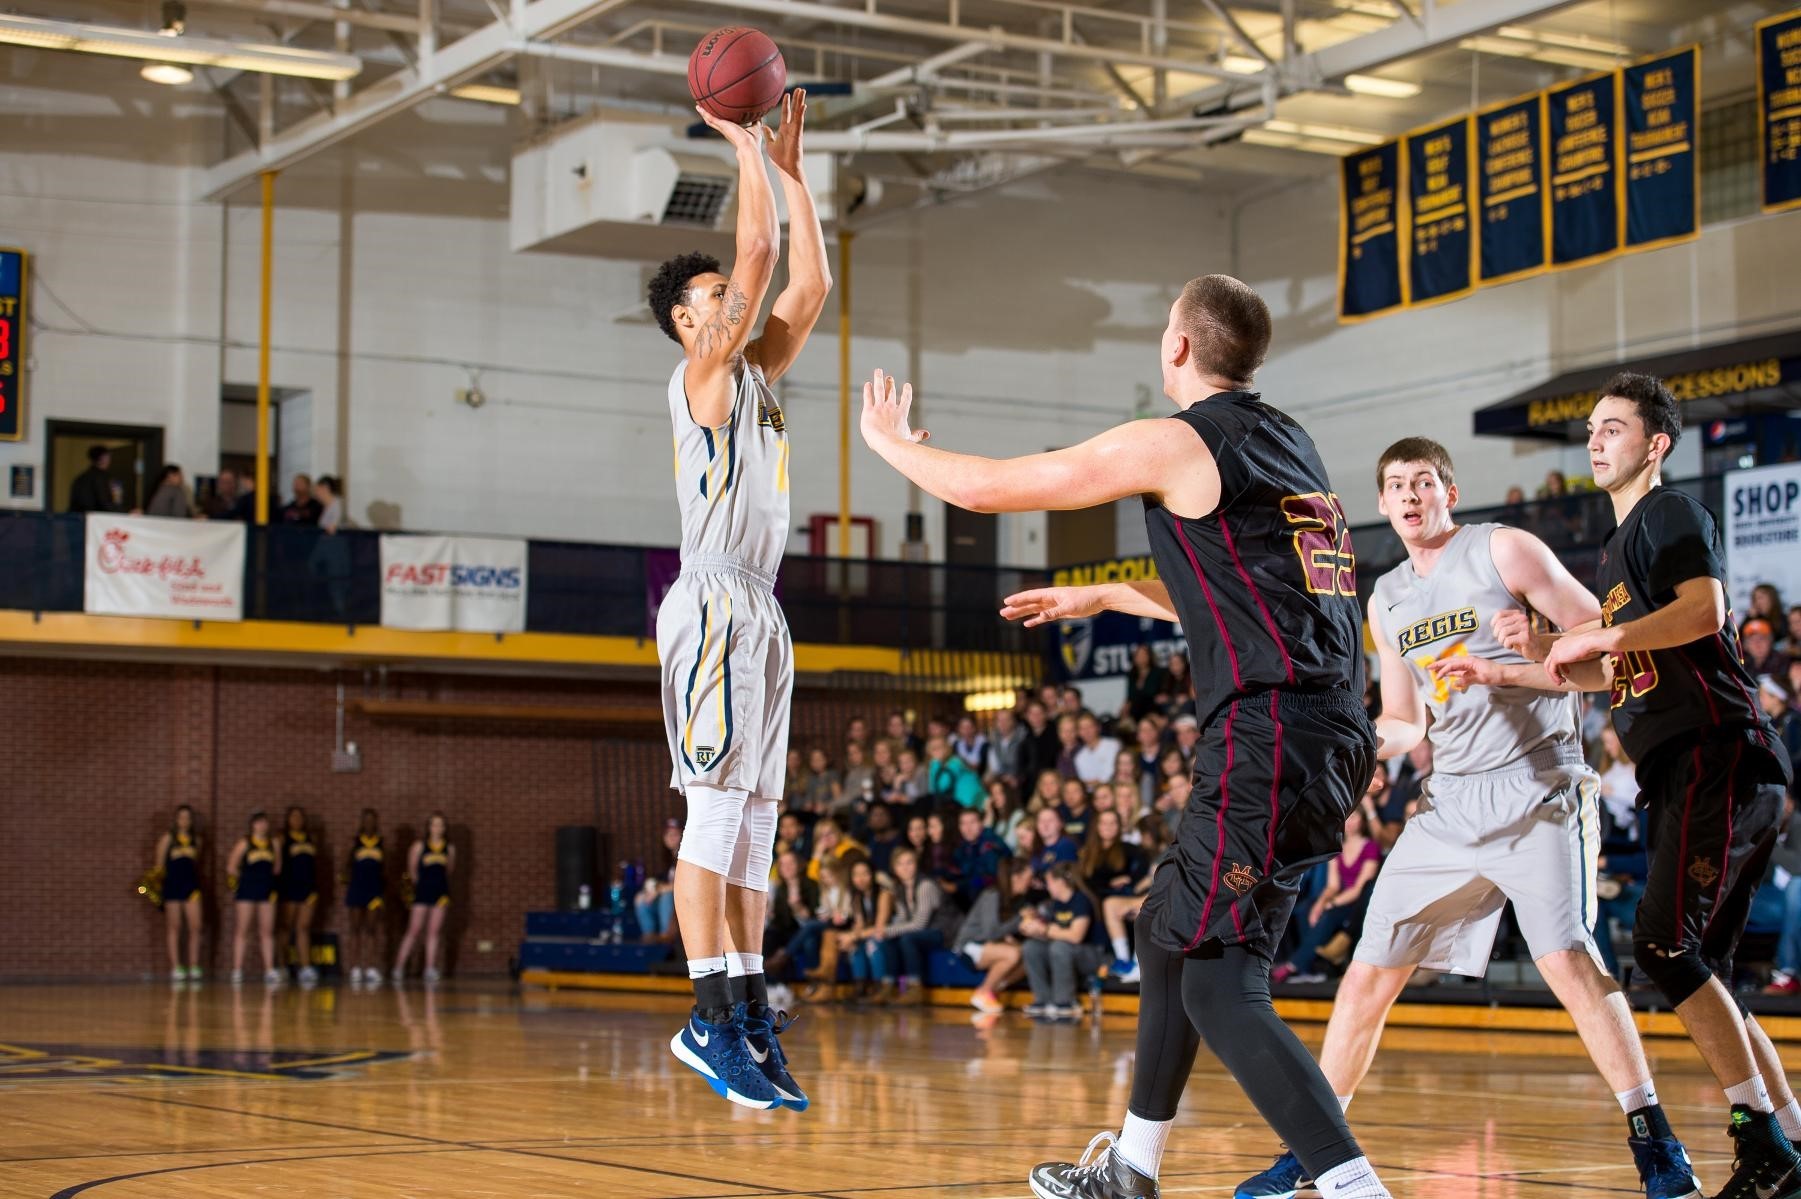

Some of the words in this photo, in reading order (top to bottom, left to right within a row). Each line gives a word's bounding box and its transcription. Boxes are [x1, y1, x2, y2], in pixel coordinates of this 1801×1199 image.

[1734, 481, 1799, 517] SHOP
[386, 561, 521, 588] FASTSIGNS
[1397, 607, 1479, 656] REGIS
